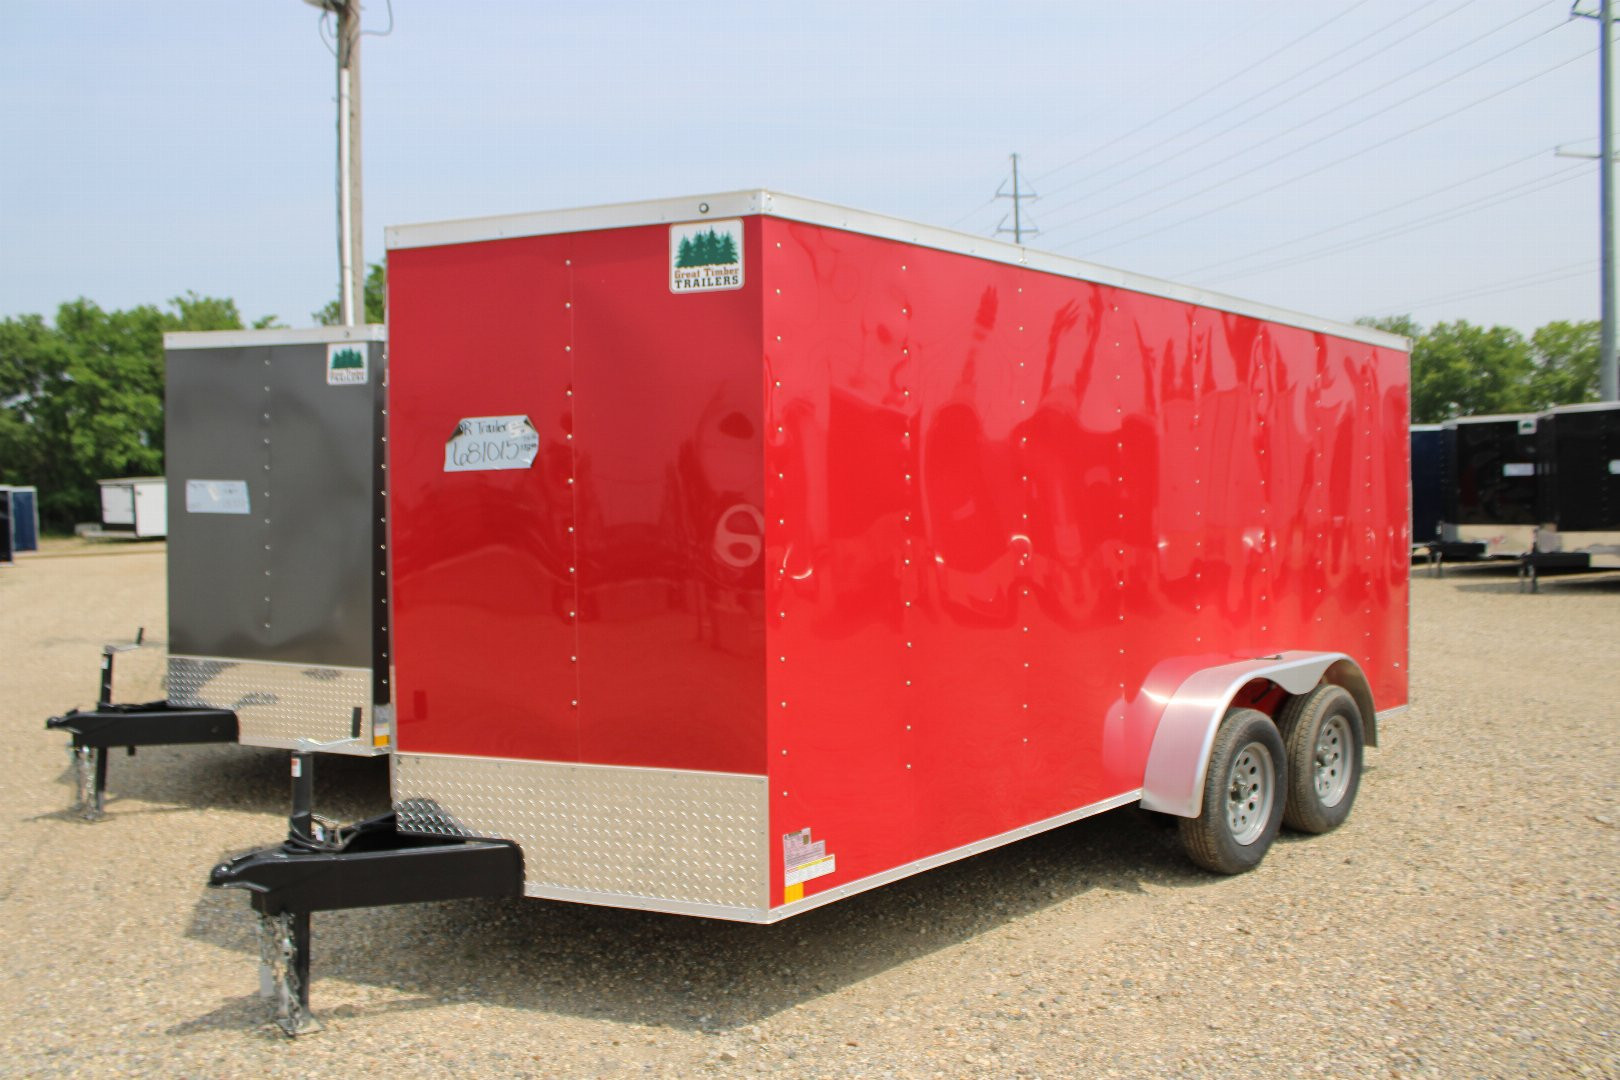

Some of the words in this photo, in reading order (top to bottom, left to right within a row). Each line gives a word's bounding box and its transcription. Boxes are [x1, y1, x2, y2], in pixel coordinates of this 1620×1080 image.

[674, 269, 700, 279] Great
[703, 266, 739, 277] Timber
[674, 275, 739, 289] TRAILERS
